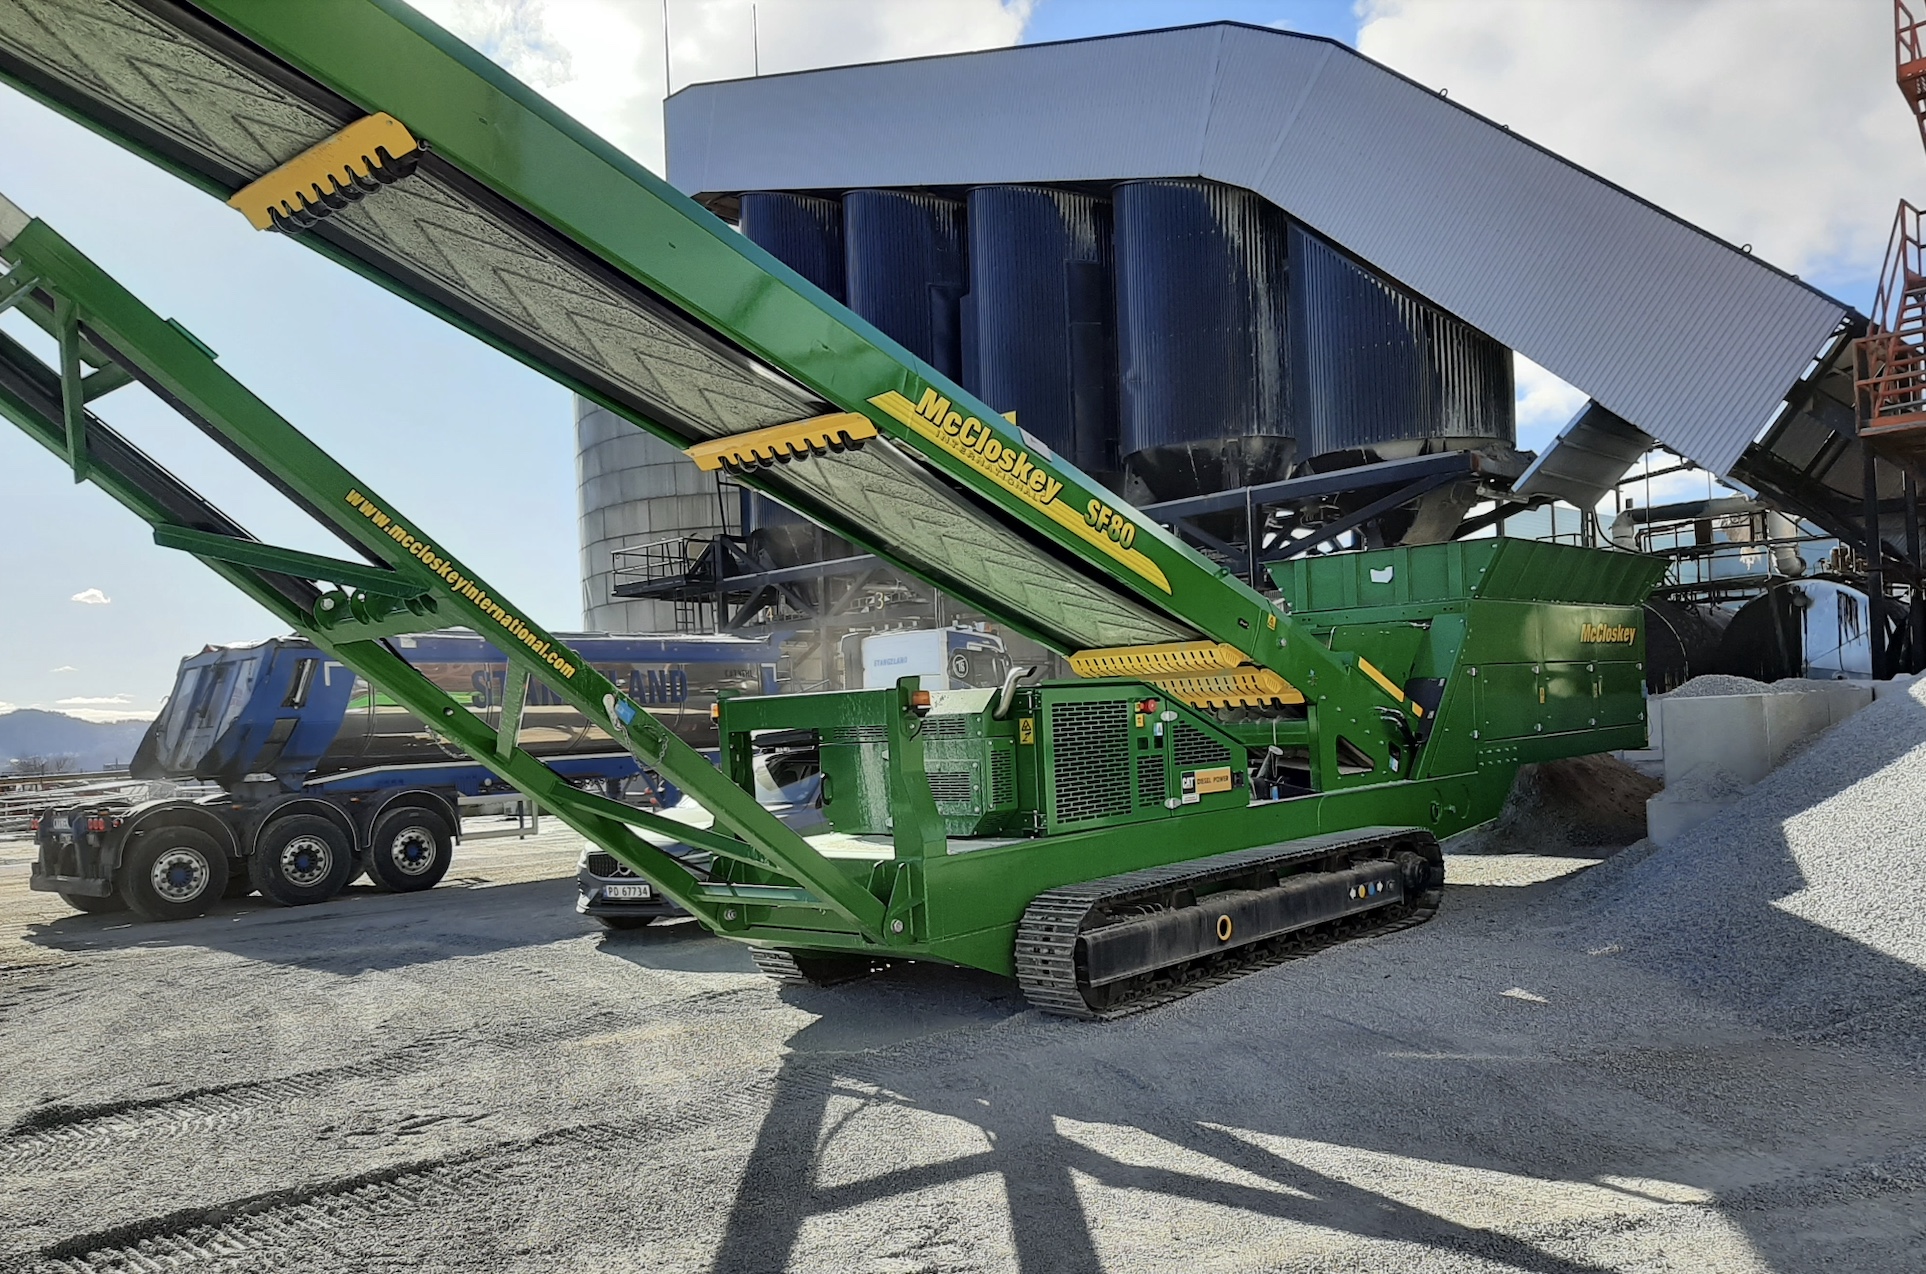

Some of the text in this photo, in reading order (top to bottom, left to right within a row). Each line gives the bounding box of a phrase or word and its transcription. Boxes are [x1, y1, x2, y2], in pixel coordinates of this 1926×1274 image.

[915, 387, 1064, 505] McCloskey
[935, 430, 1040, 502] INTERNATIONAL
[1083, 499, 1136, 550] SF80
[344, 488, 577, 679] www.mccloskeyinternational.com
[765, 605, 774, 622] 4
[875, 591, 884, 610] 3
[1580, 623, 1637, 646] McCloskey
[471, 669, 688, 708] STANAND
[1182, 775, 1229, 789] CAT DIESEL POWER
[622, 886, 648, 897] 67734
